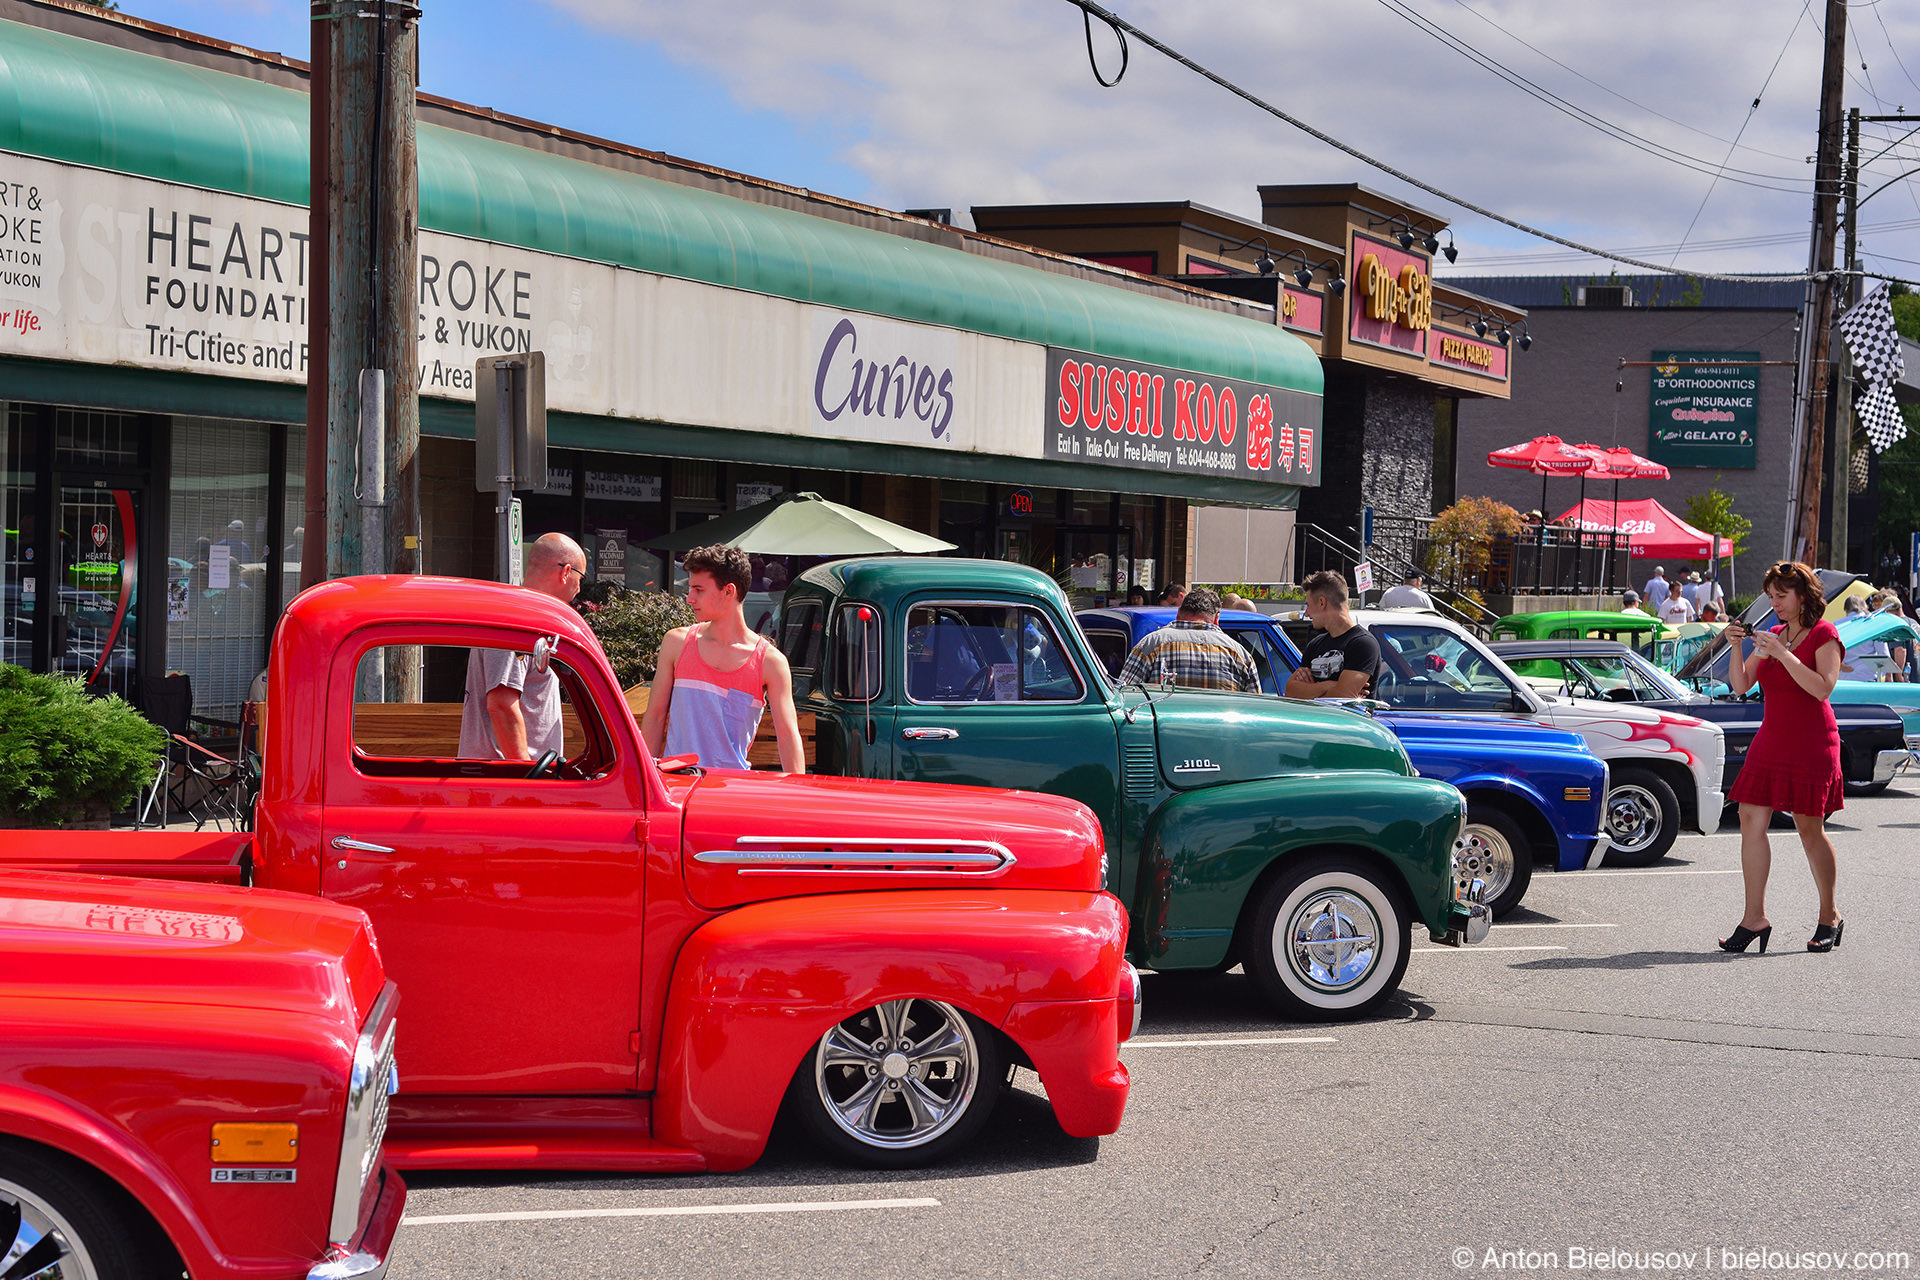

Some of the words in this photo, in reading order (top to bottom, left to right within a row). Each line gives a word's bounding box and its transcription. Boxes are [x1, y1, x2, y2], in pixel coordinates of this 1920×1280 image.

[147, 207, 310, 286] HEART
[146, 275, 305, 325] FOUNDATI
[420, 254, 531, 320] ROKE
[13, 309, 42, 335] life.
[434, 316, 449, 344] &
[457, 319, 531, 353] YUKON
[145, 324, 247, 366] Tri-Cities
[252, 340, 293, 370] and
[1443, 336, 1465, 361] PIZZA
[1466, 343, 1493, 368] PARLOR
[431, 359, 473, 390] Area
[814, 318, 954, 440] Curves
[1058, 358, 1165, 438] SUSHI
[1173, 378, 1238, 447] KOO
[1692, 396, 1753, 407] INSURANCE
[1057, 433, 1071, 454] Eat
[1072, 434, 1081, 455] In
[1085, 436, 1103, 457] Take
[1104, 438, 1120, 459] Out
[1123, 440, 1141, 461] Free
[1141, 442, 1172, 469] Delivery
[1176, 446, 1187, 465] Tel:
[1188, 448, 1237, 471] 604-468-8883
[1684, 431, 1736, 441] GELATO
[1010, 493, 1033, 513] OPEN
[1183, 759, 1211, 768] 3100
[214, 1170, 229, 1181] 8
[235, 1170, 287, 1181] 350
